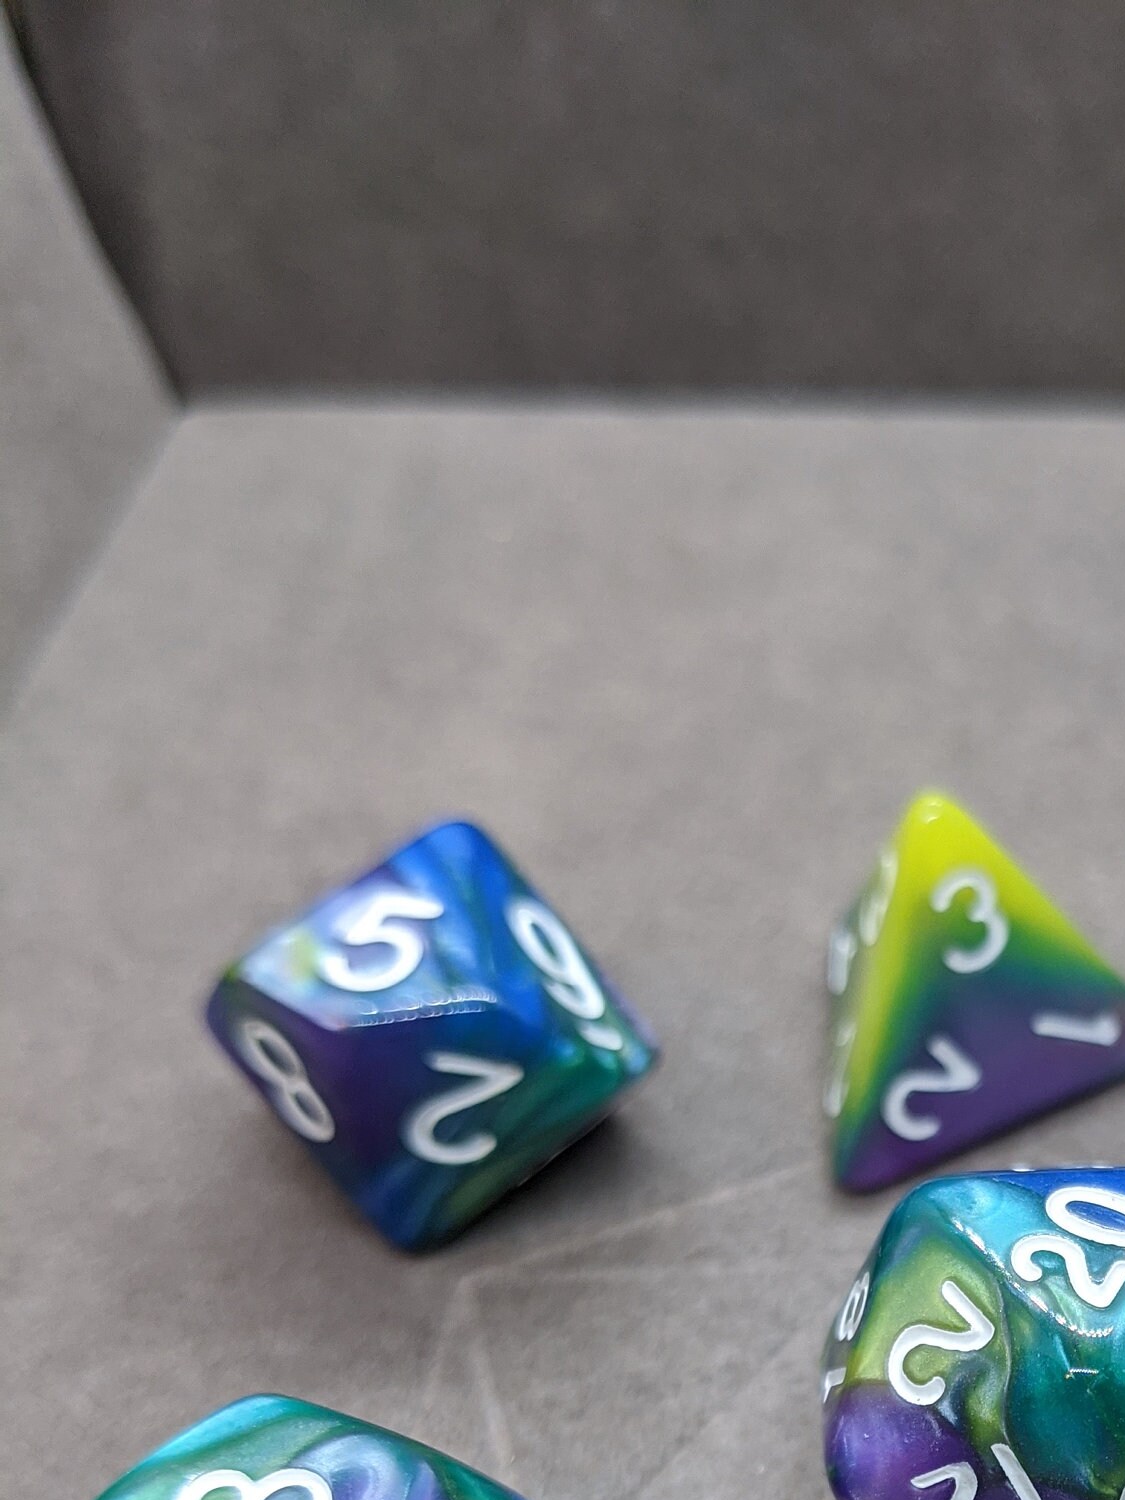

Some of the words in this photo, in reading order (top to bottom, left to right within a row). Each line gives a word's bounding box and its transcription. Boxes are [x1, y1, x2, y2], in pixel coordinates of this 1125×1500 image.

[318, 890, 445, 992] 5
[931, 869, 1009, 973] 3
[1031, 1008, 1120, 1046] 1
[241, 1018, 335, 1142] 8
[405, 1052, 524, 1165] 2
[883, 1036, 982, 1141] 2
[888, 1280, 995, 1405] 2
